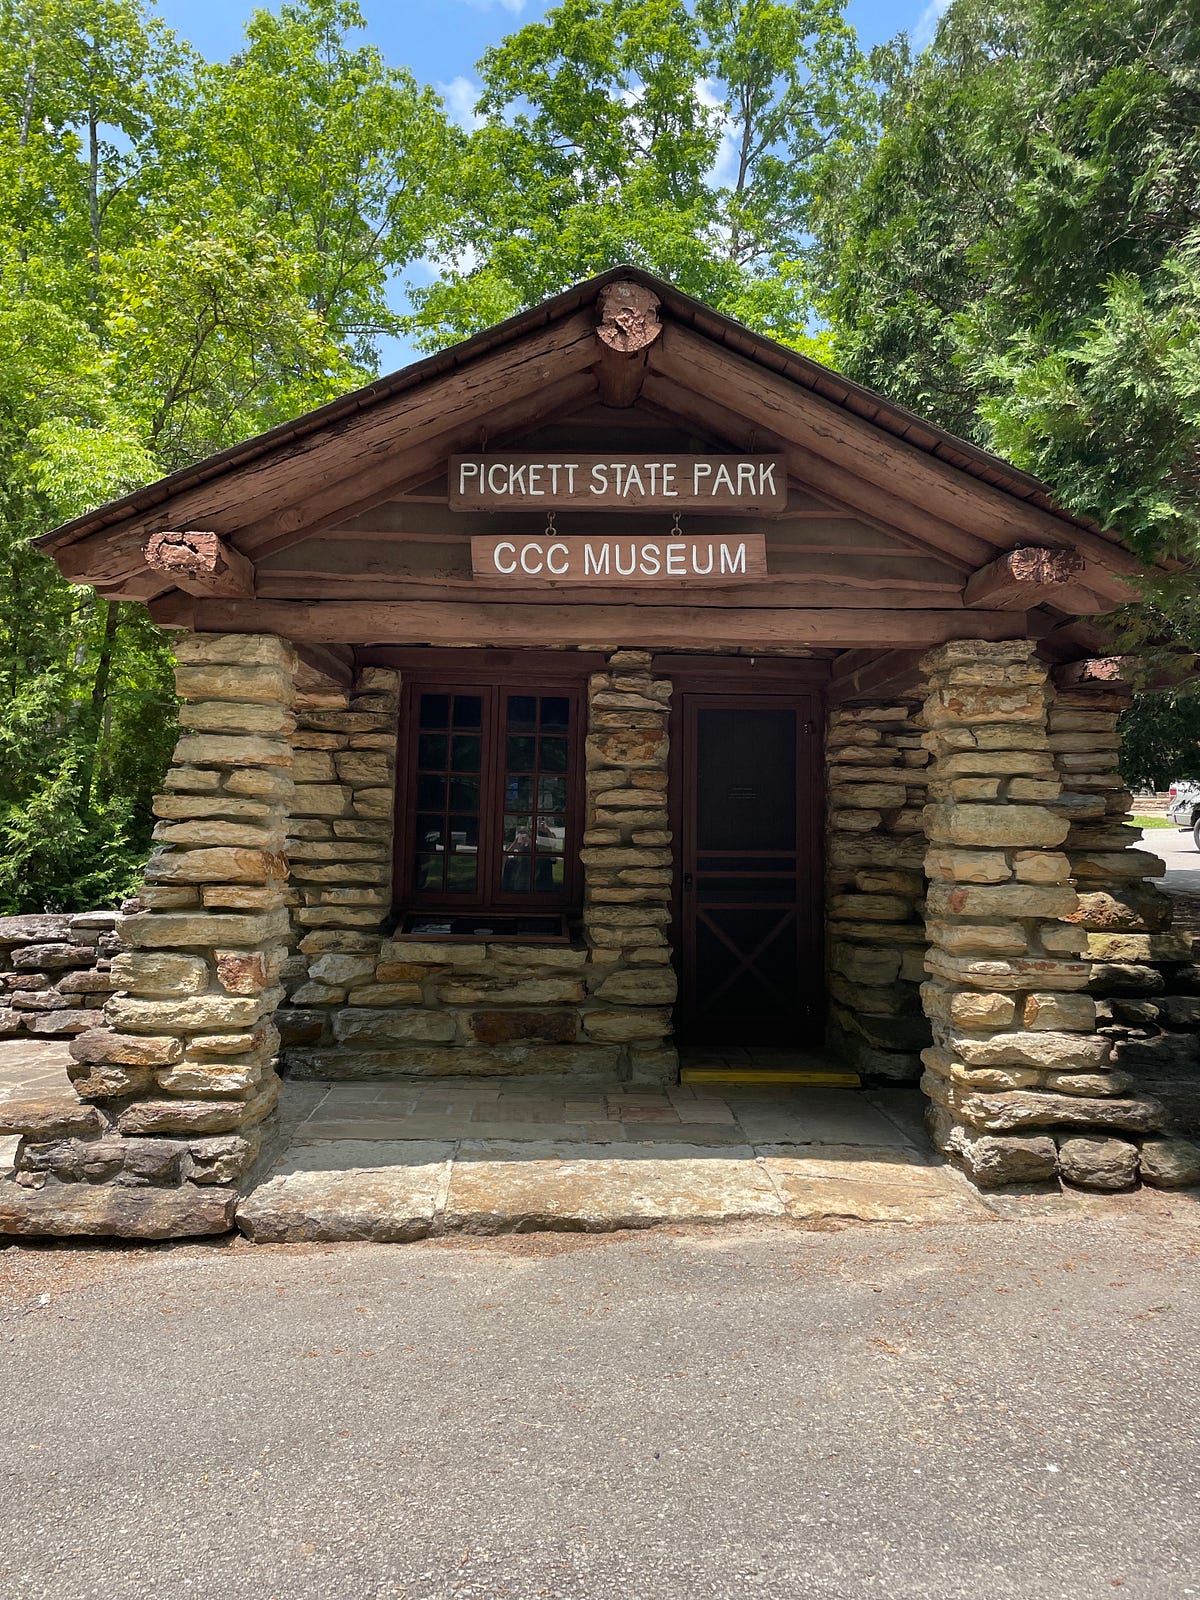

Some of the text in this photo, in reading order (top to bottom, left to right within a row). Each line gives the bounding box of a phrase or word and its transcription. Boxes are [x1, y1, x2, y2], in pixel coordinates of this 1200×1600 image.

[460, 463, 777, 497] PICKETT STATE PARK
[493, 542, 746, 575] CCC MUSEUM
